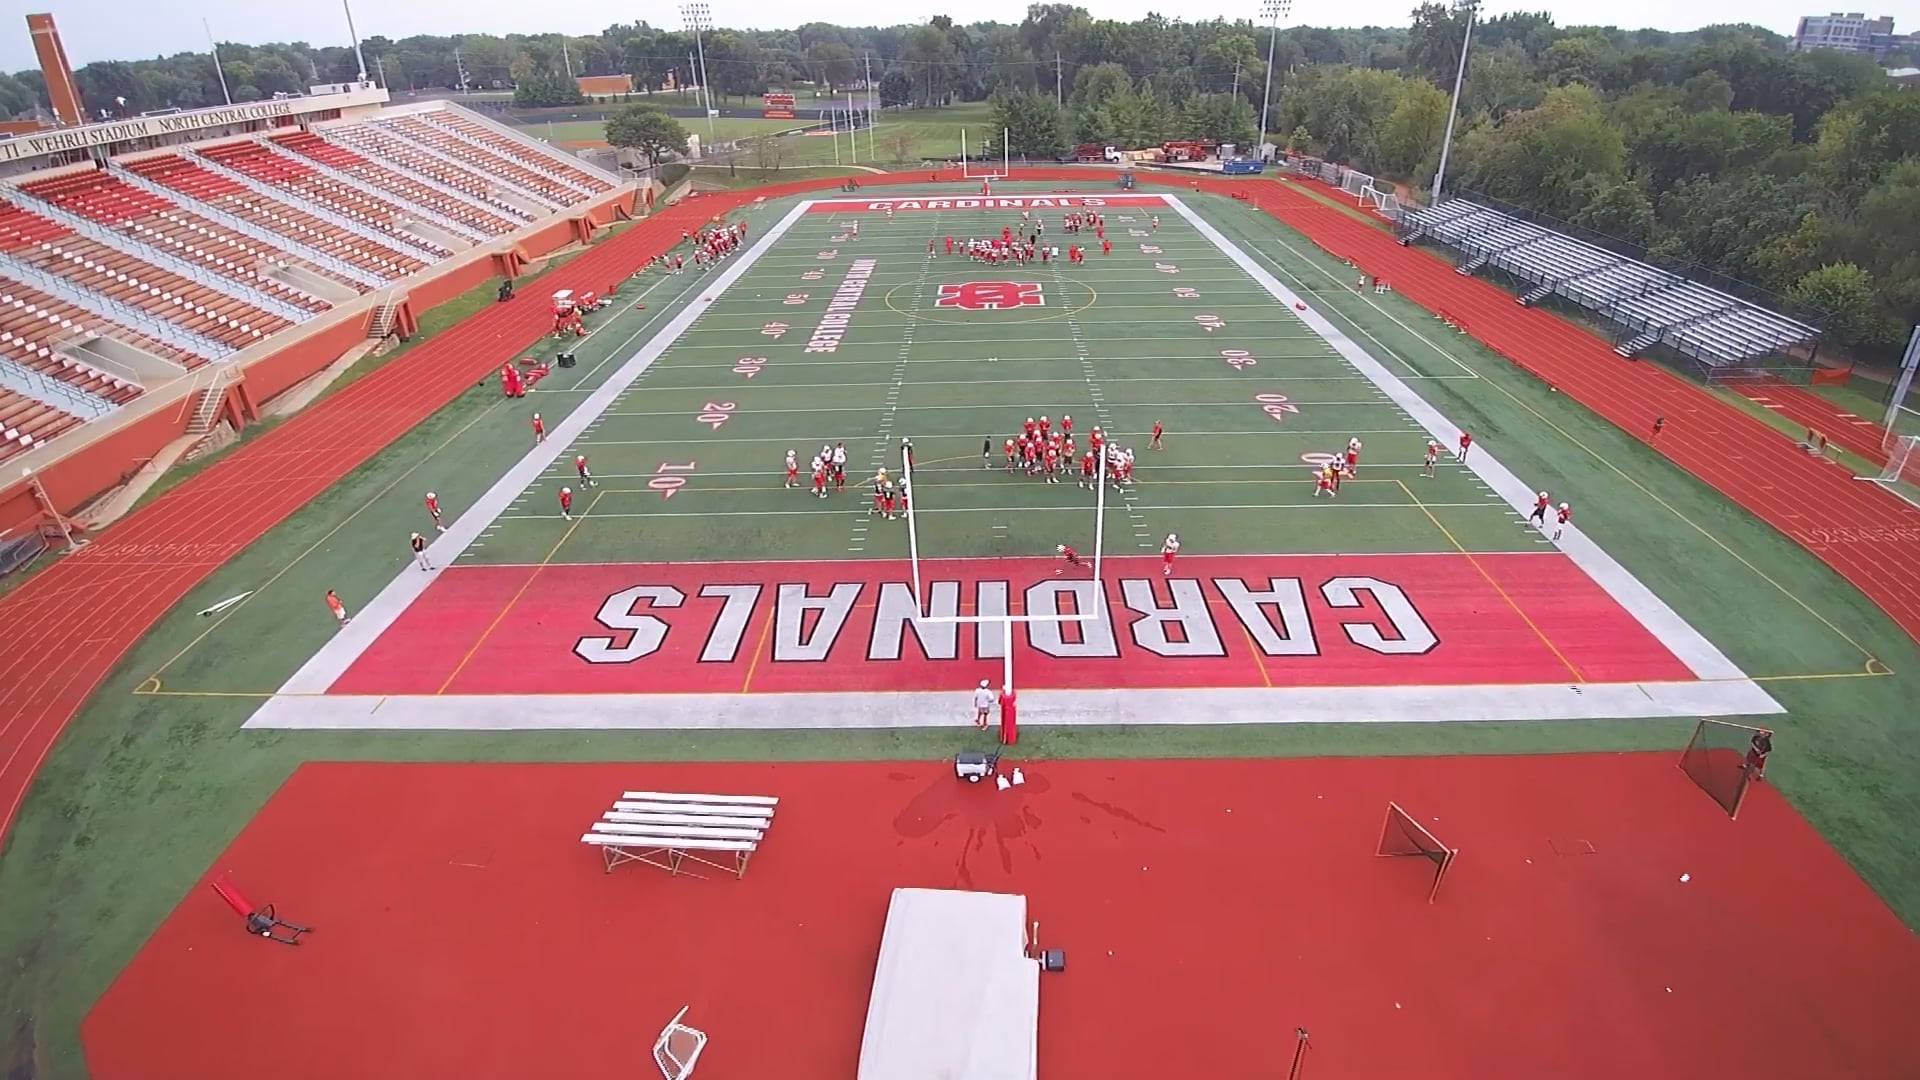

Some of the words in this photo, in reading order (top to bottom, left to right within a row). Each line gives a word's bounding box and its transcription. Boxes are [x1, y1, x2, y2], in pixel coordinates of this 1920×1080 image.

[1, 143, 20, 160] TI
[28, 131, 90, 153] WEHRLI
[89, 122, 149, 144] STADIUM
[159, 114, 202, 132] NORTH
[201, 108, 250, 126] CENTRAL
[249, 102, 292, 119] COLLEGE
[868, 198, 1108, 210] CARDINALS
[845, 259, 877, 279] NORTH
[783, 293, 809, 305] 50
[826, 279, 868, 312] CENTRAL
[1172, 287, 1201, 298] 50
[761, 321, 790, 335] 40
[1194, 314, 1227, 328] 40
[804, 313, 852, 353] COLLEGE
[732, 357, 768, 373] 30
[1221, 349, 1257, 366] 30
[696, 402, 737, 422] 20
[1254, 393, 1300, 413] 20
[648, 461, 697, 489] 10
[573, 577, 1440, 664] CARDINALS
